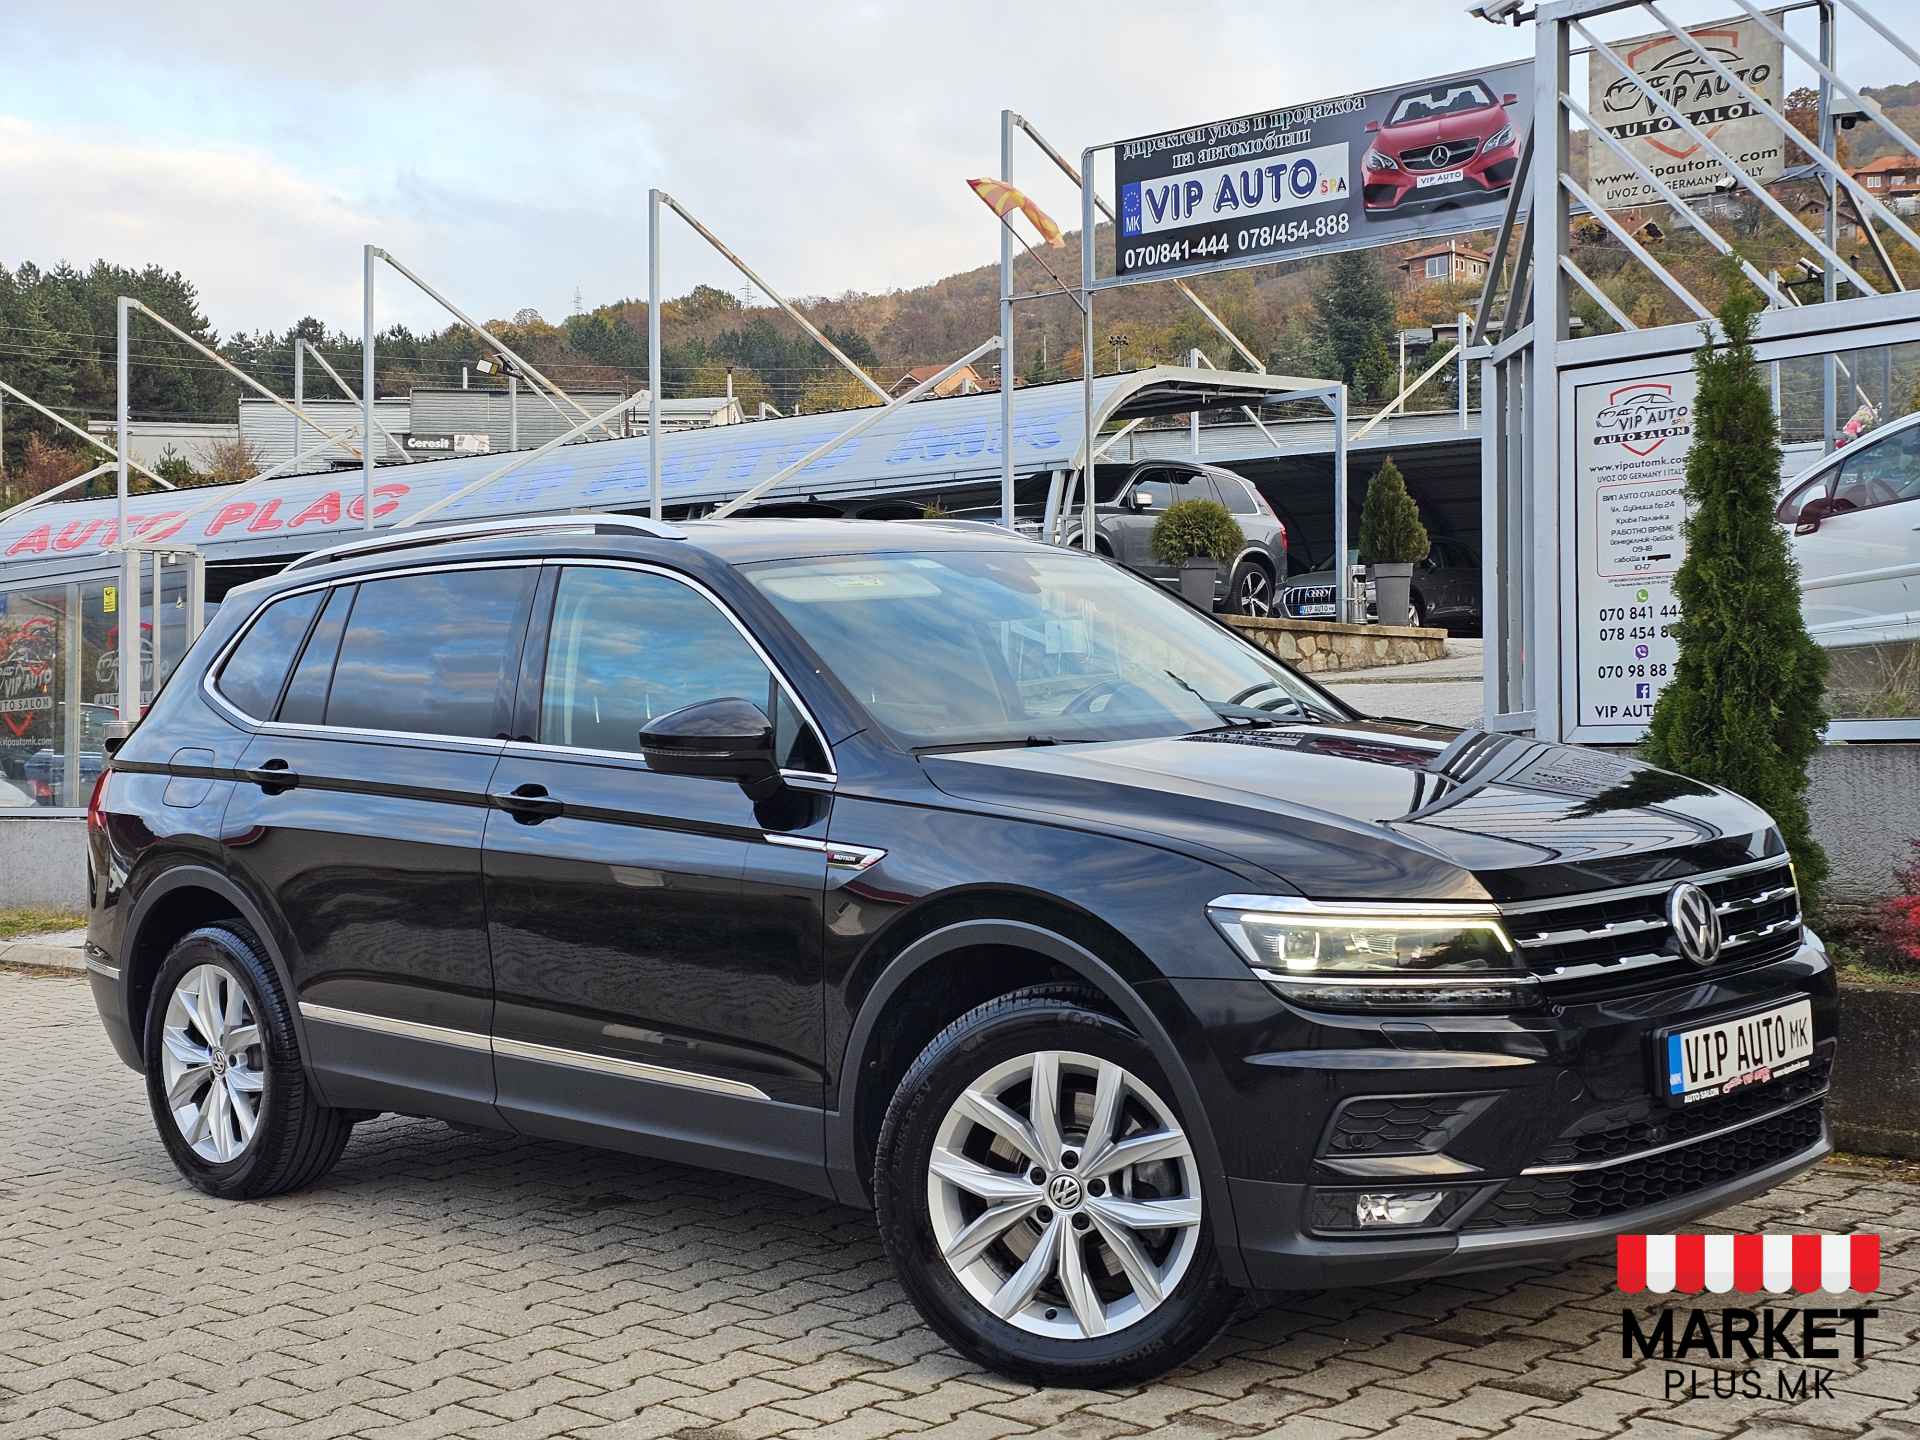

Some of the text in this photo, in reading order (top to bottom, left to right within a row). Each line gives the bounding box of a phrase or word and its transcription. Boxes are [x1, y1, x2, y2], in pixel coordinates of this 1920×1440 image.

[1208, 119, 1250, 145] увоз
[1609, 117, 1673, 139] AUTO
[1173, 128, 1311, 168] на автомобили
[1595, 148, 1778, 186] www.ipautom.com
[1421, 171, 1462, 185] VIP AUTO
[1146, 179, 1203, 224] VIP
[1213, 158, 1317, 213] AUTO
[1606, 186, 1638, 200] UVOZ
[1126, 216, 1141, 233] MK
[1125, 213, 1350, 269] 070/841-444 078/454-888
[1619, 406, 1688, 431] VIP AUTO
[407, 437, 450, 449] Ceresit
[1599, 427, 1686, 444] AUTO SALON
[5, 511, 189, 557] AUTO
[1599, 608, 1625, 621] 070
[1630, 606, 1653, 619] 841
[1599, 627, 1625, 641] 078
[1630, 626, 1655, 640] 454
[1598, 666, 1623, 679] 070
[1628, 664, 1645, 677] 98
[1650, 663, 1667, 676] 88
[97, 692, 119, 705] AUT
[1595, 704, 1653, 718] VIP AUT
[1685, 1030, 1728, 1084] VIP
[1737, 1014, 1786, 1072] AUTO
[1789, 1016, 1809, 1050] MK
